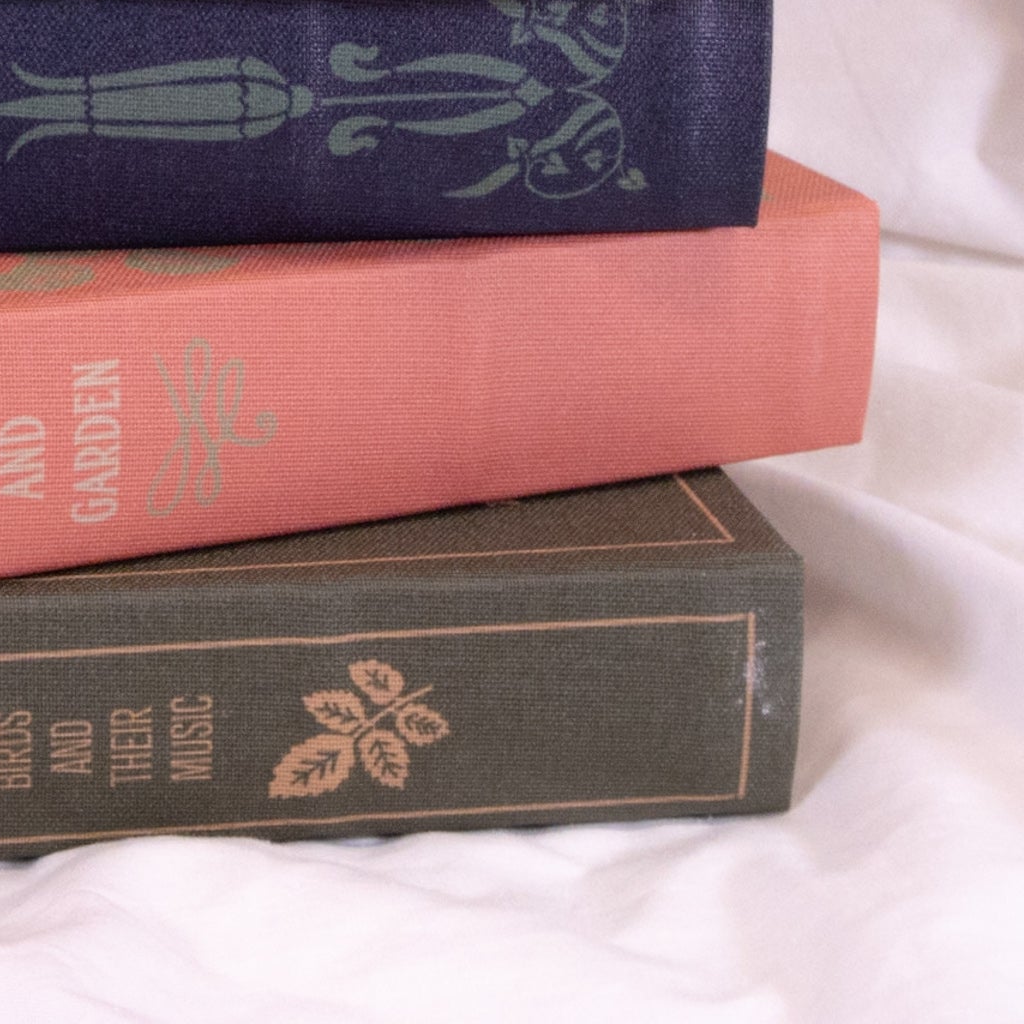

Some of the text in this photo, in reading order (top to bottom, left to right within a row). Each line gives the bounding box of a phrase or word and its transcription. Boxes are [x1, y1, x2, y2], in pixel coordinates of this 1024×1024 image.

[70, 358, 123, 524] GARDEN
[50, 719, 93, 775] AND
[109, 705, 153, 789] THEIR
[170, 694, 214, 782] MUSIC
